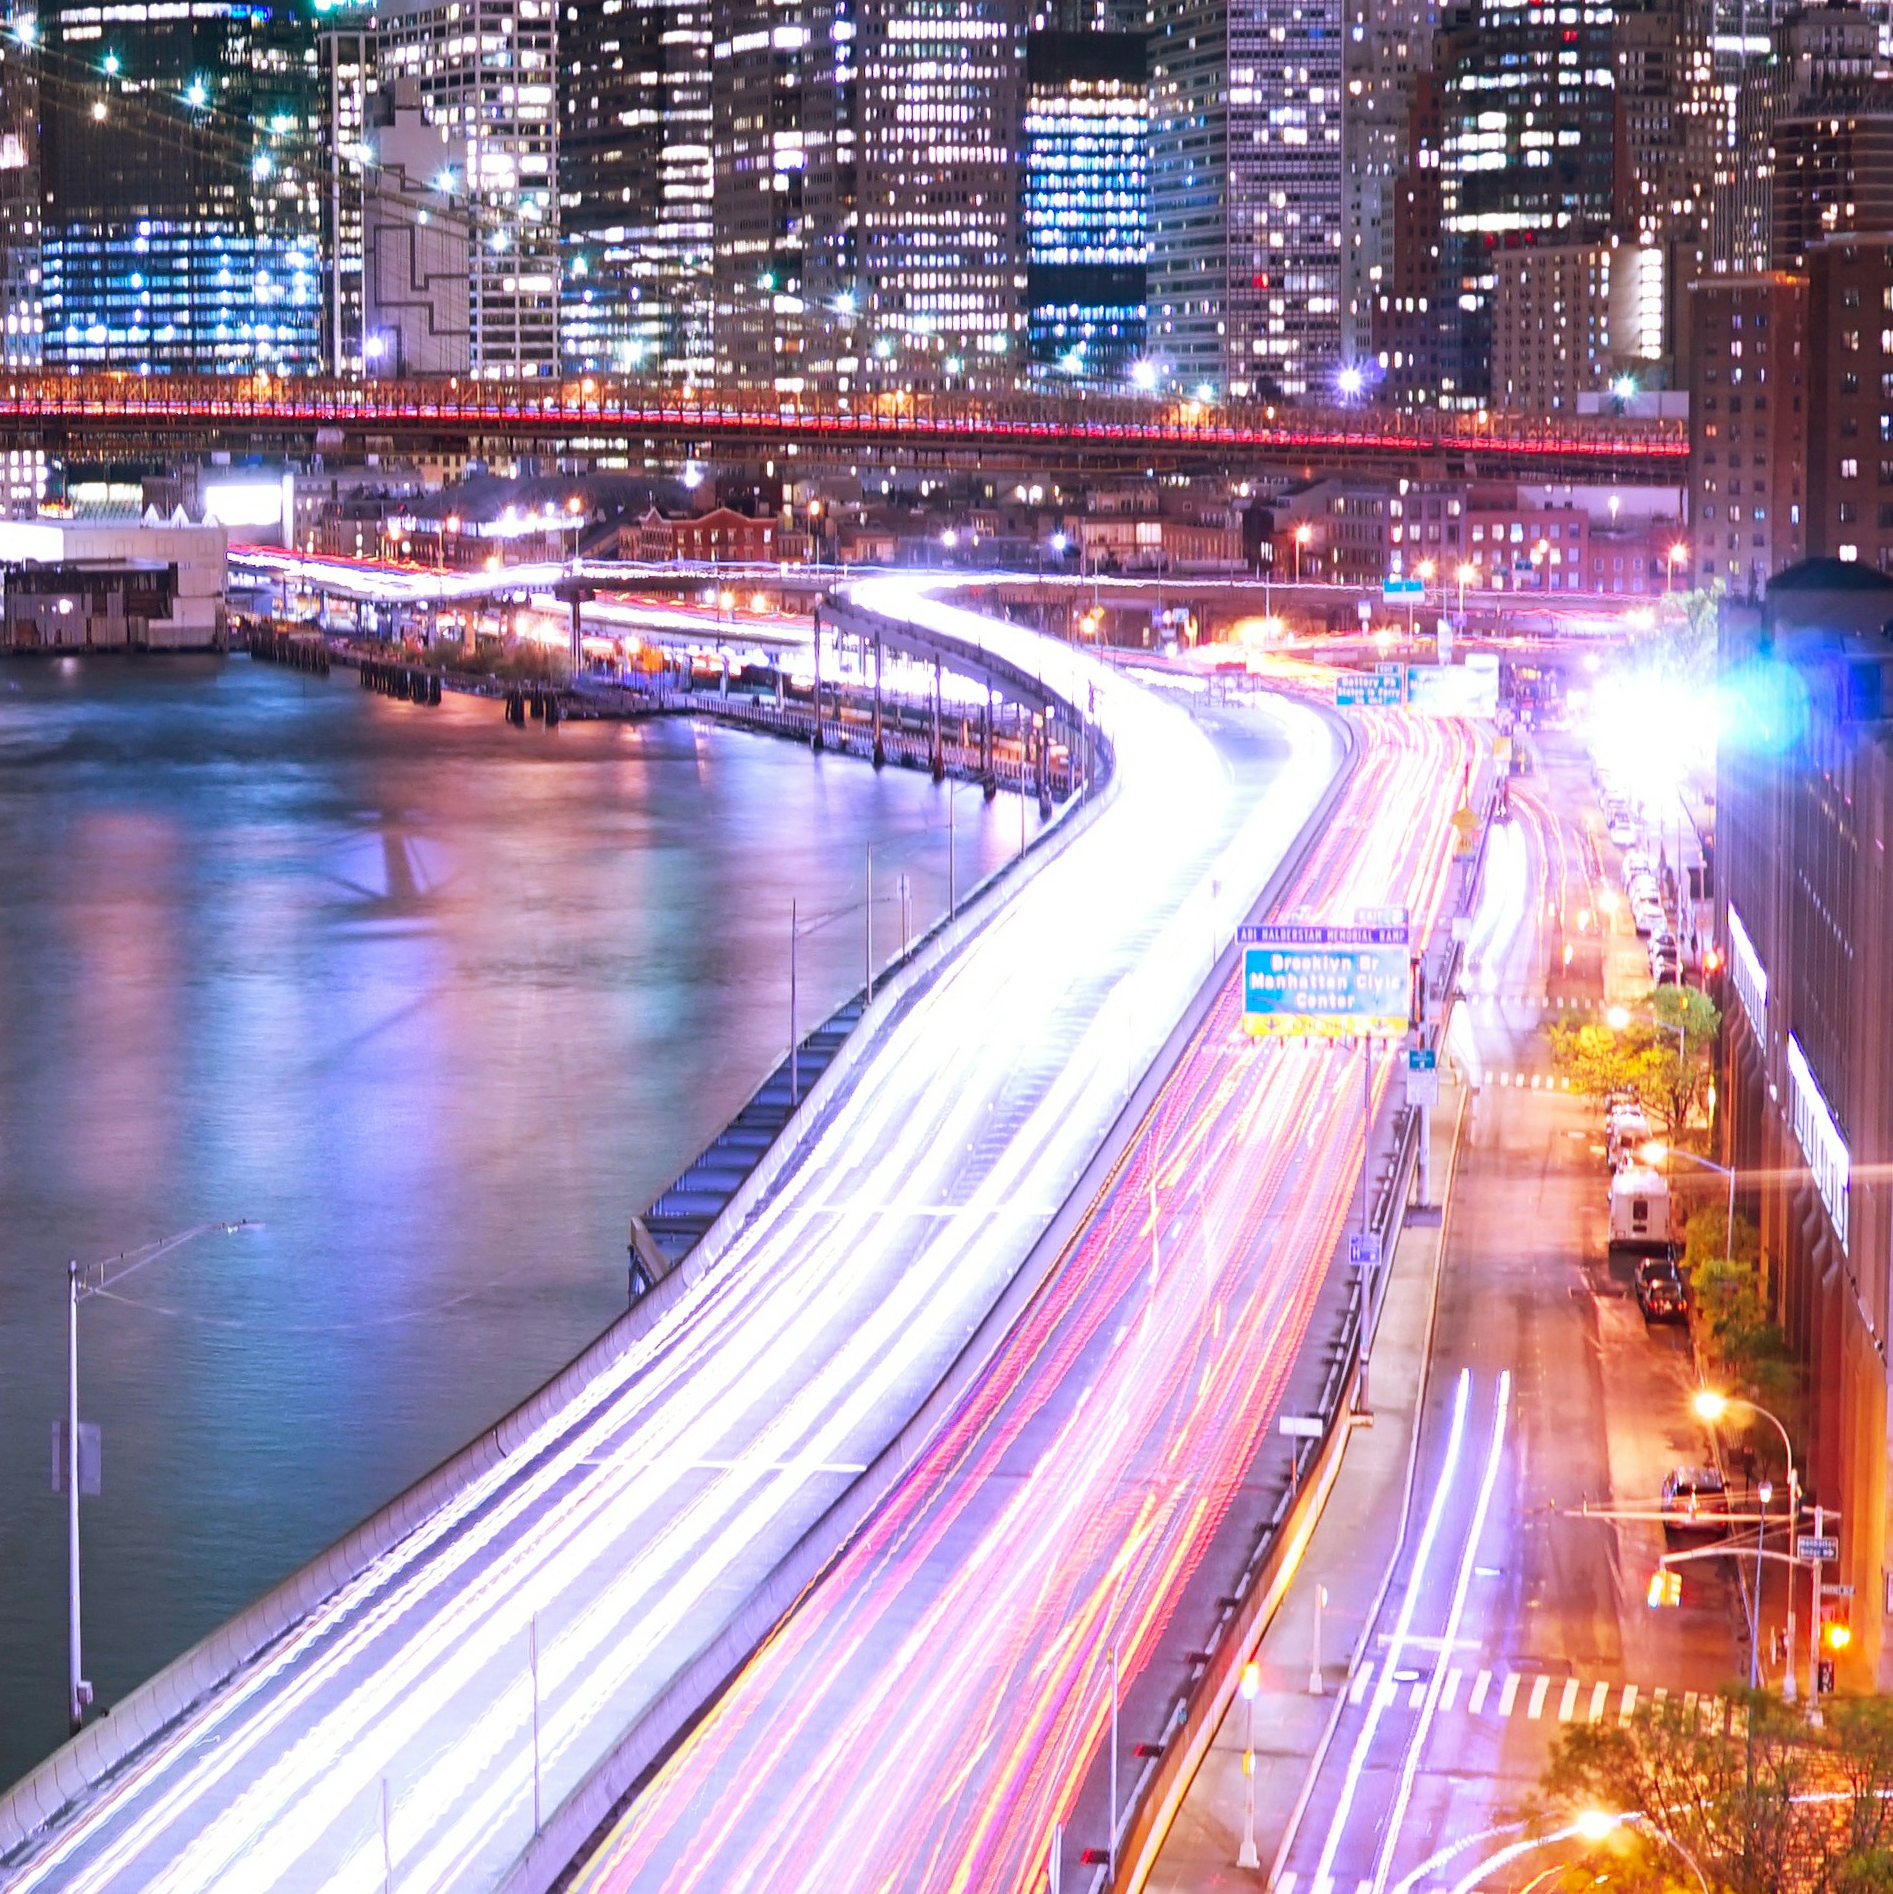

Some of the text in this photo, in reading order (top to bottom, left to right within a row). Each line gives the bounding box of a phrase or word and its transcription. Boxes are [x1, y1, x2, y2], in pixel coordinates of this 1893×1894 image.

[1327, 928, 1373, 942] MEMORIAL
[1379, 929, 1405, 943] RAMP
[1271, 953, 1379, 972] Brooklyn Br
[1249, 971, 1401, 992] Manhattan Civic
[1295, 991, 1355, 1009] Center
